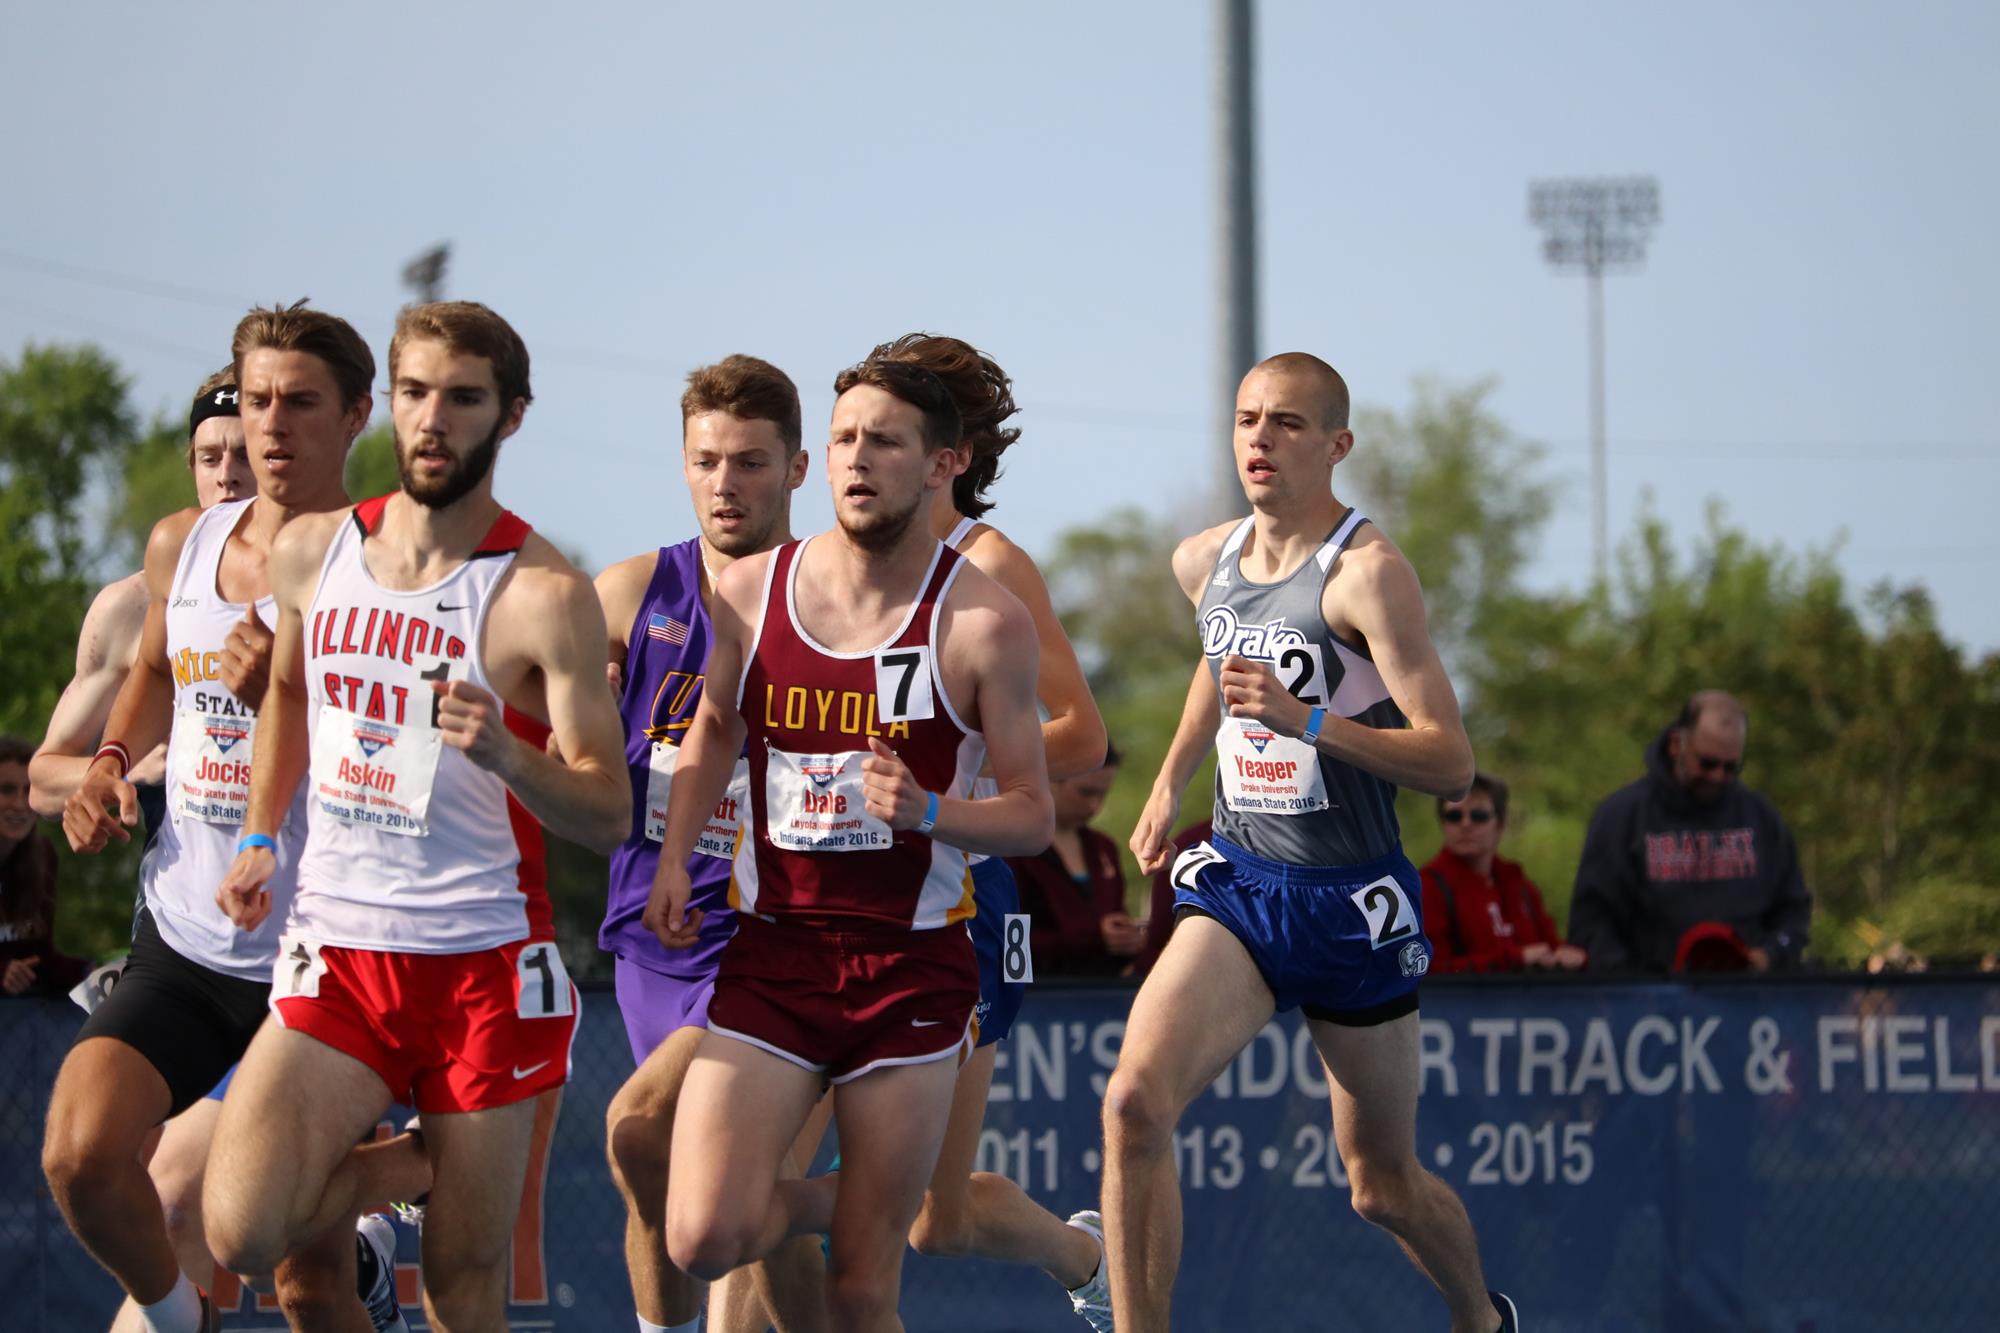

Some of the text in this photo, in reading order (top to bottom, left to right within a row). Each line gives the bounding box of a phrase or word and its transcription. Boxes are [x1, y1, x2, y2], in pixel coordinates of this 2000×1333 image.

[881, 652, 921, 717] 7
[1280, 648, 1321, 705] 2
[195, 692, 258, 719] STAT
[324, 671, 409, 726] STAT
[420, 661, 451, 729] 1
[337, 756, 397, 793] Askin
[1234, 754, 1298, 783] Yeager
[203, 788, 227, 801] State
[344, 790, 368, 804] State
[805, 788, 848, 815] Dale
[1233, 795, 1316, 810] Indiana State 2016
[1240, 782, 1299, 795] Drake University
[211, 804, 241, 819] State
[353, 807, 383, 825] State
[386, 813, 417, 830] 2016
[818, 819, 864, 831] University
[703, 824, 738, 838] orthern
[780, 832, 814, 847] Indiana
[848, 832, 879, 846] 2016
[1364, 885, 1412, 944] 2
[1005, 918, 1026, 980] 8
[524, 946, 555, 1014] 1
[1470, 1017, 1723, 1097] TRACK
[1745, 1017, 1796, 1095] &
[974, 1127, 1060, 1192] 011
[1467, 1122, 1594, 1187] 2015
